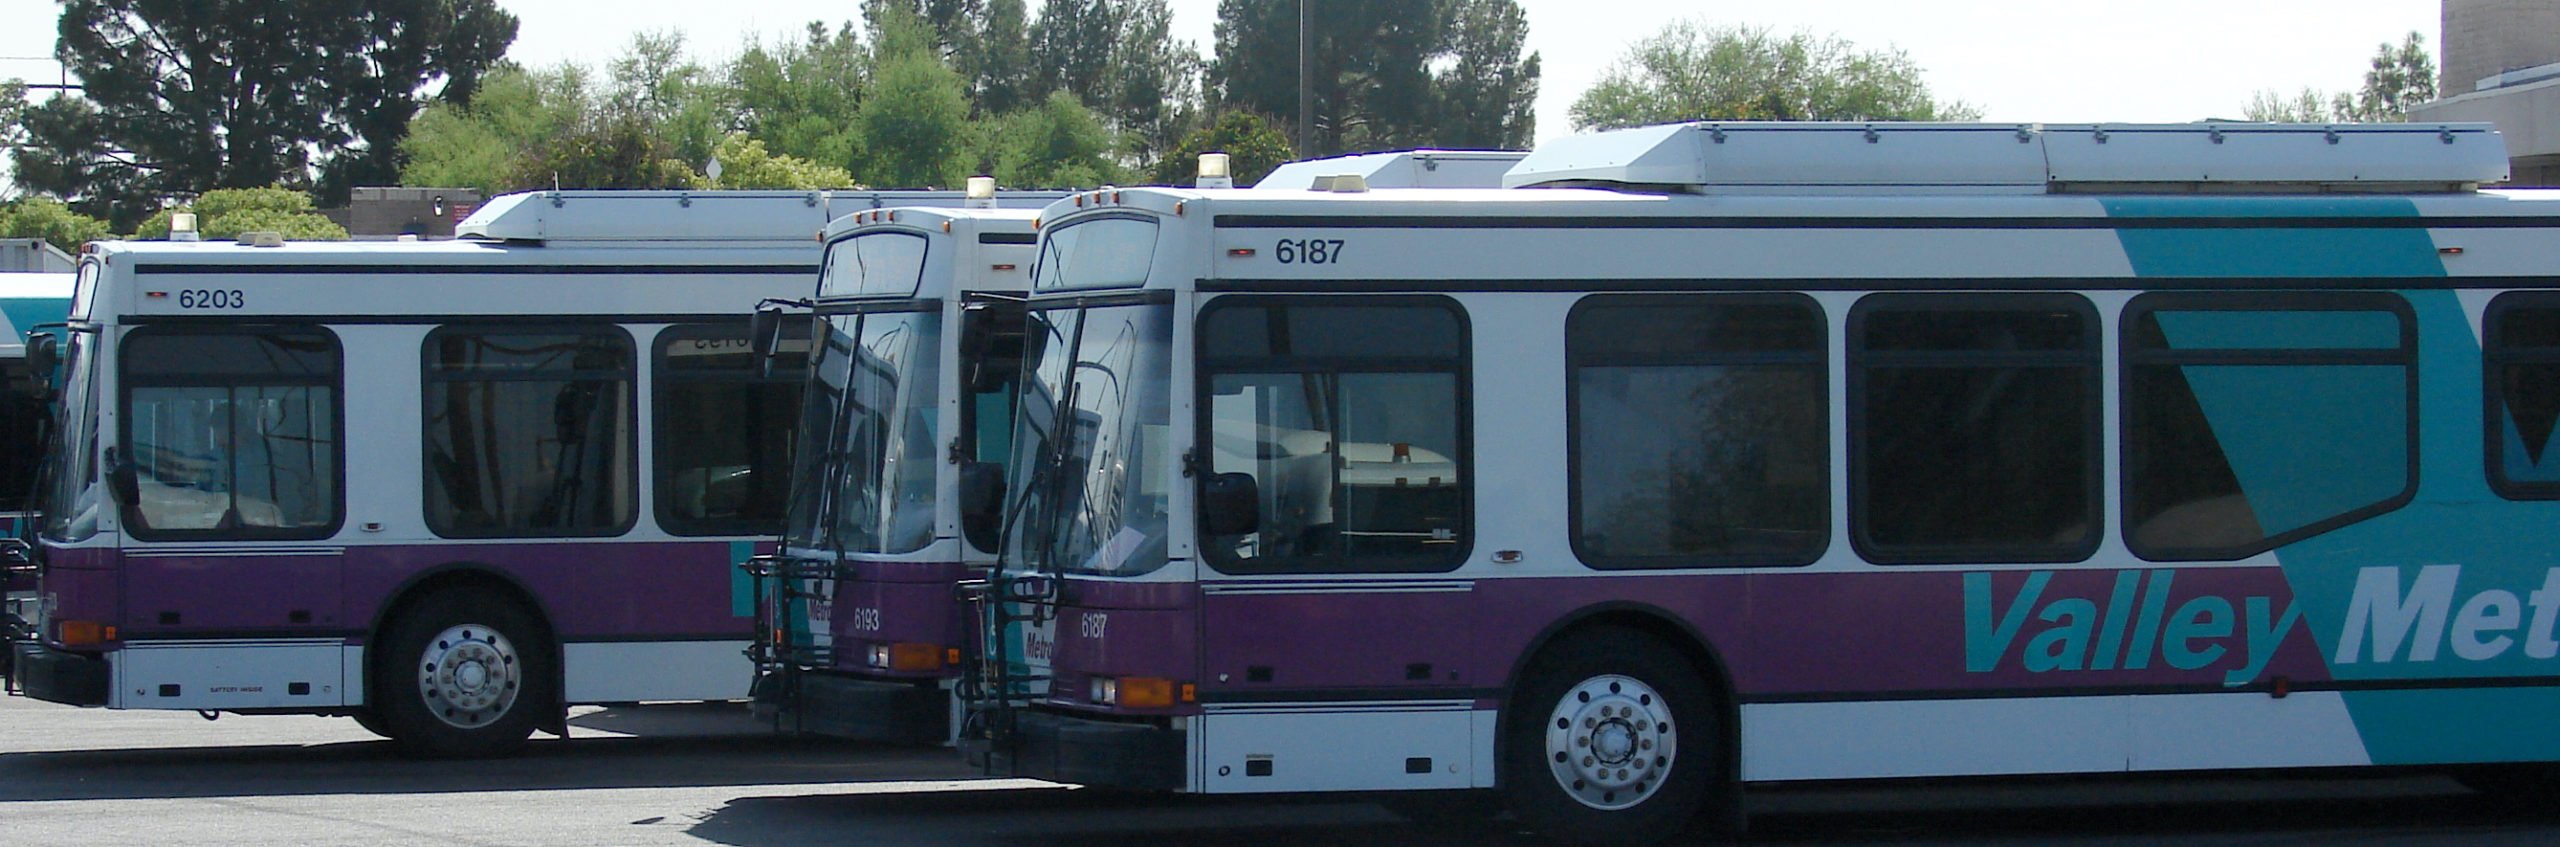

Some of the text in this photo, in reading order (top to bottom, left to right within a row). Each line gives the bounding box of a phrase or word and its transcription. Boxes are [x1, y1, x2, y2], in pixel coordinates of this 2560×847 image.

[1276, 238, 1345, 264] 6187
[179, 289, 244, 309] 6203
[854, 607, 879, 631] 6193
[1081, 612, 1107, 638] 6187
[1963, 564, 2560, 688] Valley Met
